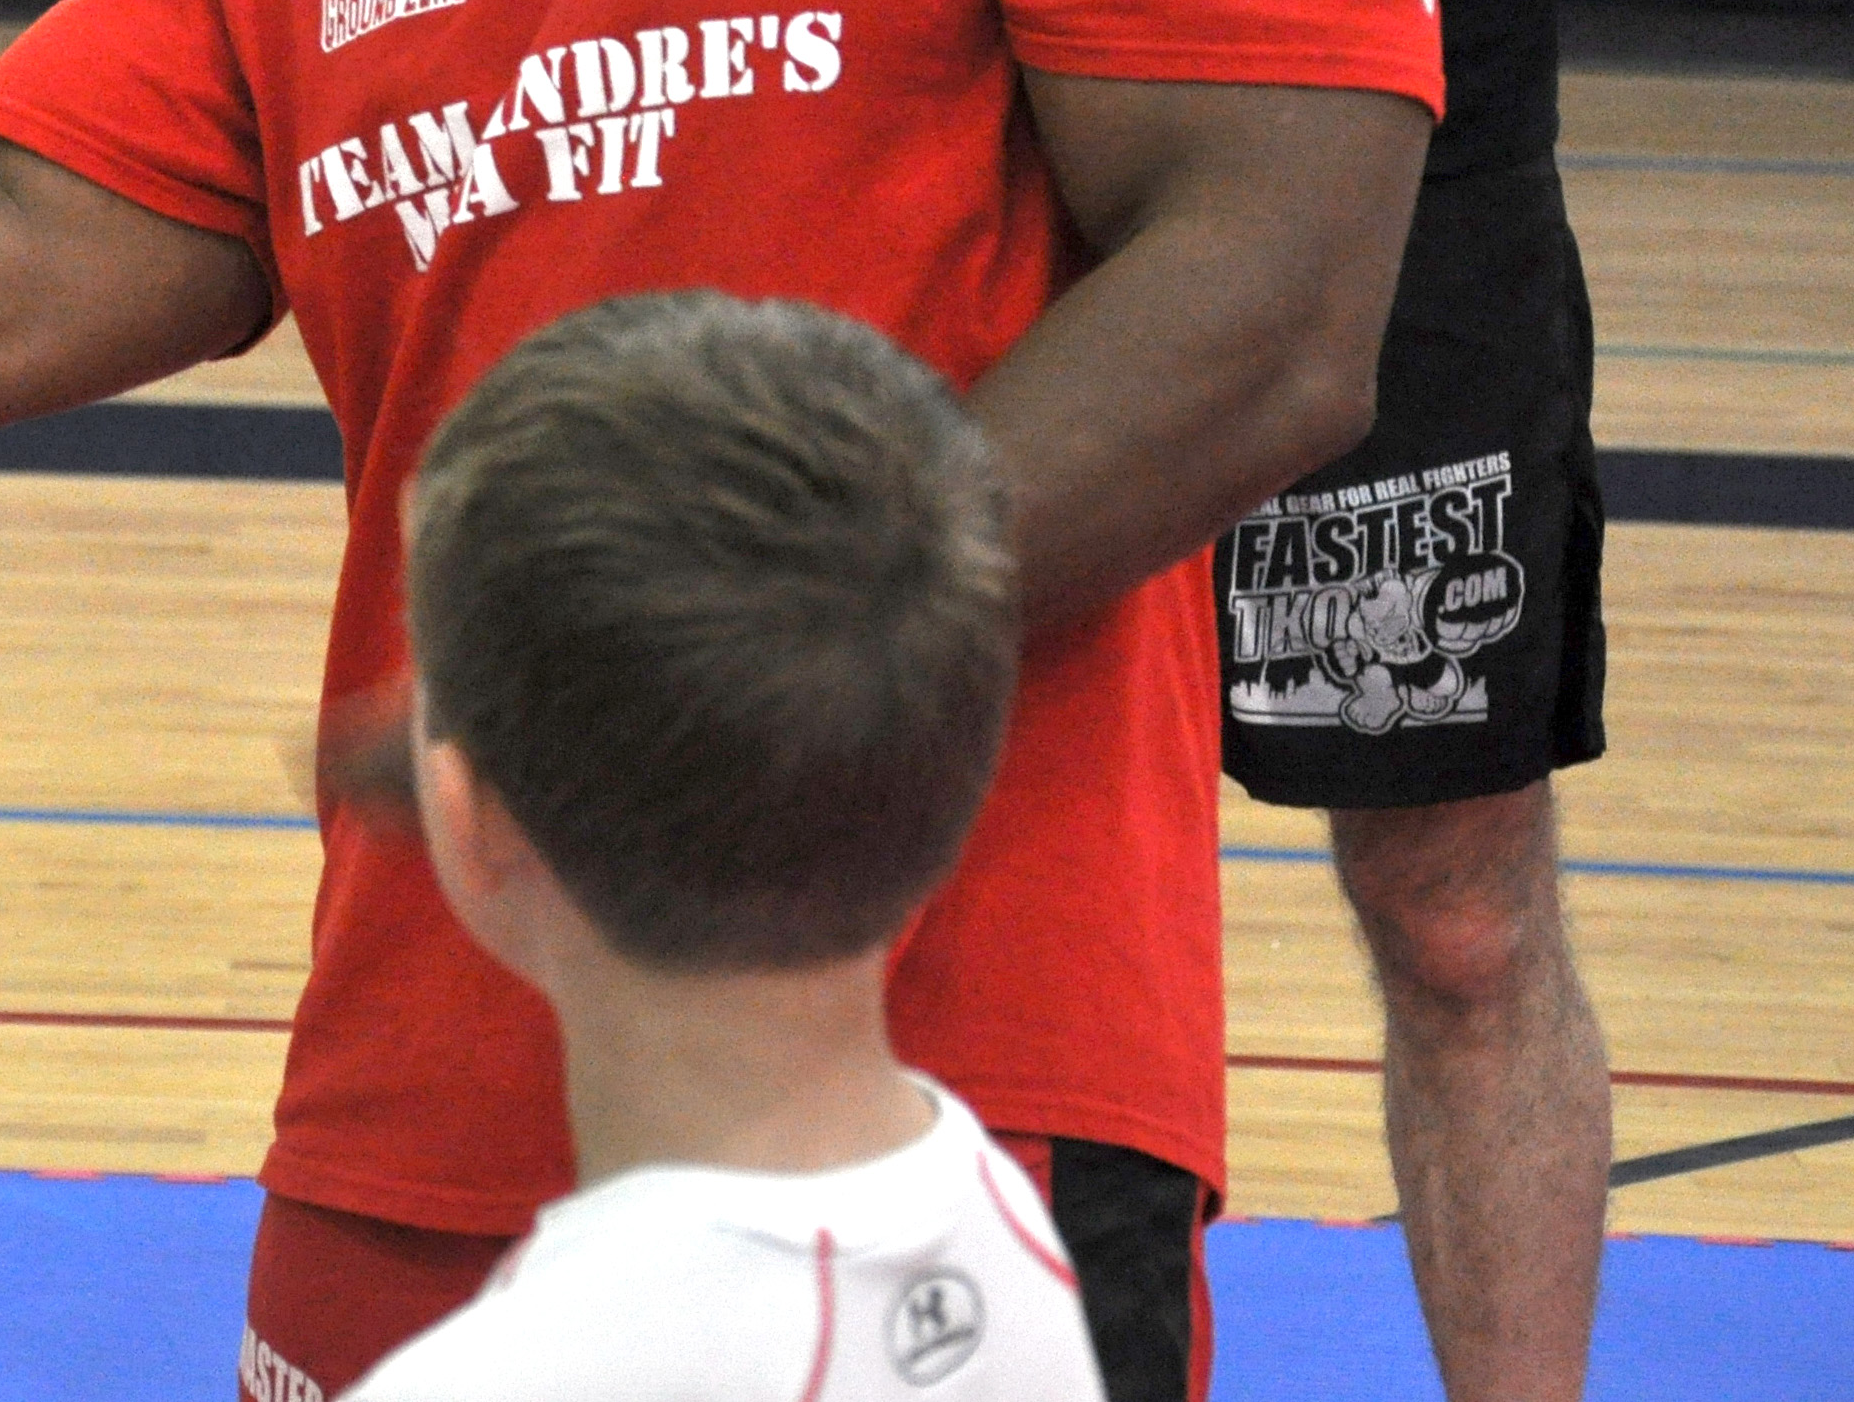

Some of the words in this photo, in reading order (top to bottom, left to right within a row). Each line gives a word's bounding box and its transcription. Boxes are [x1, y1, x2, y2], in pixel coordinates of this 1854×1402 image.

[299, 101, 475, 237] TEAM
[536, 108, 675, 202] FIT
[1337, 484, 1373, 508] FOR
[1373, 472, 1421, 499] REAL
[1422, 451, 1512, 491] FIGHTERS
[1231, 473, 1512, 594] FASTEST
[1437, 565, 1509, 615] .COM
